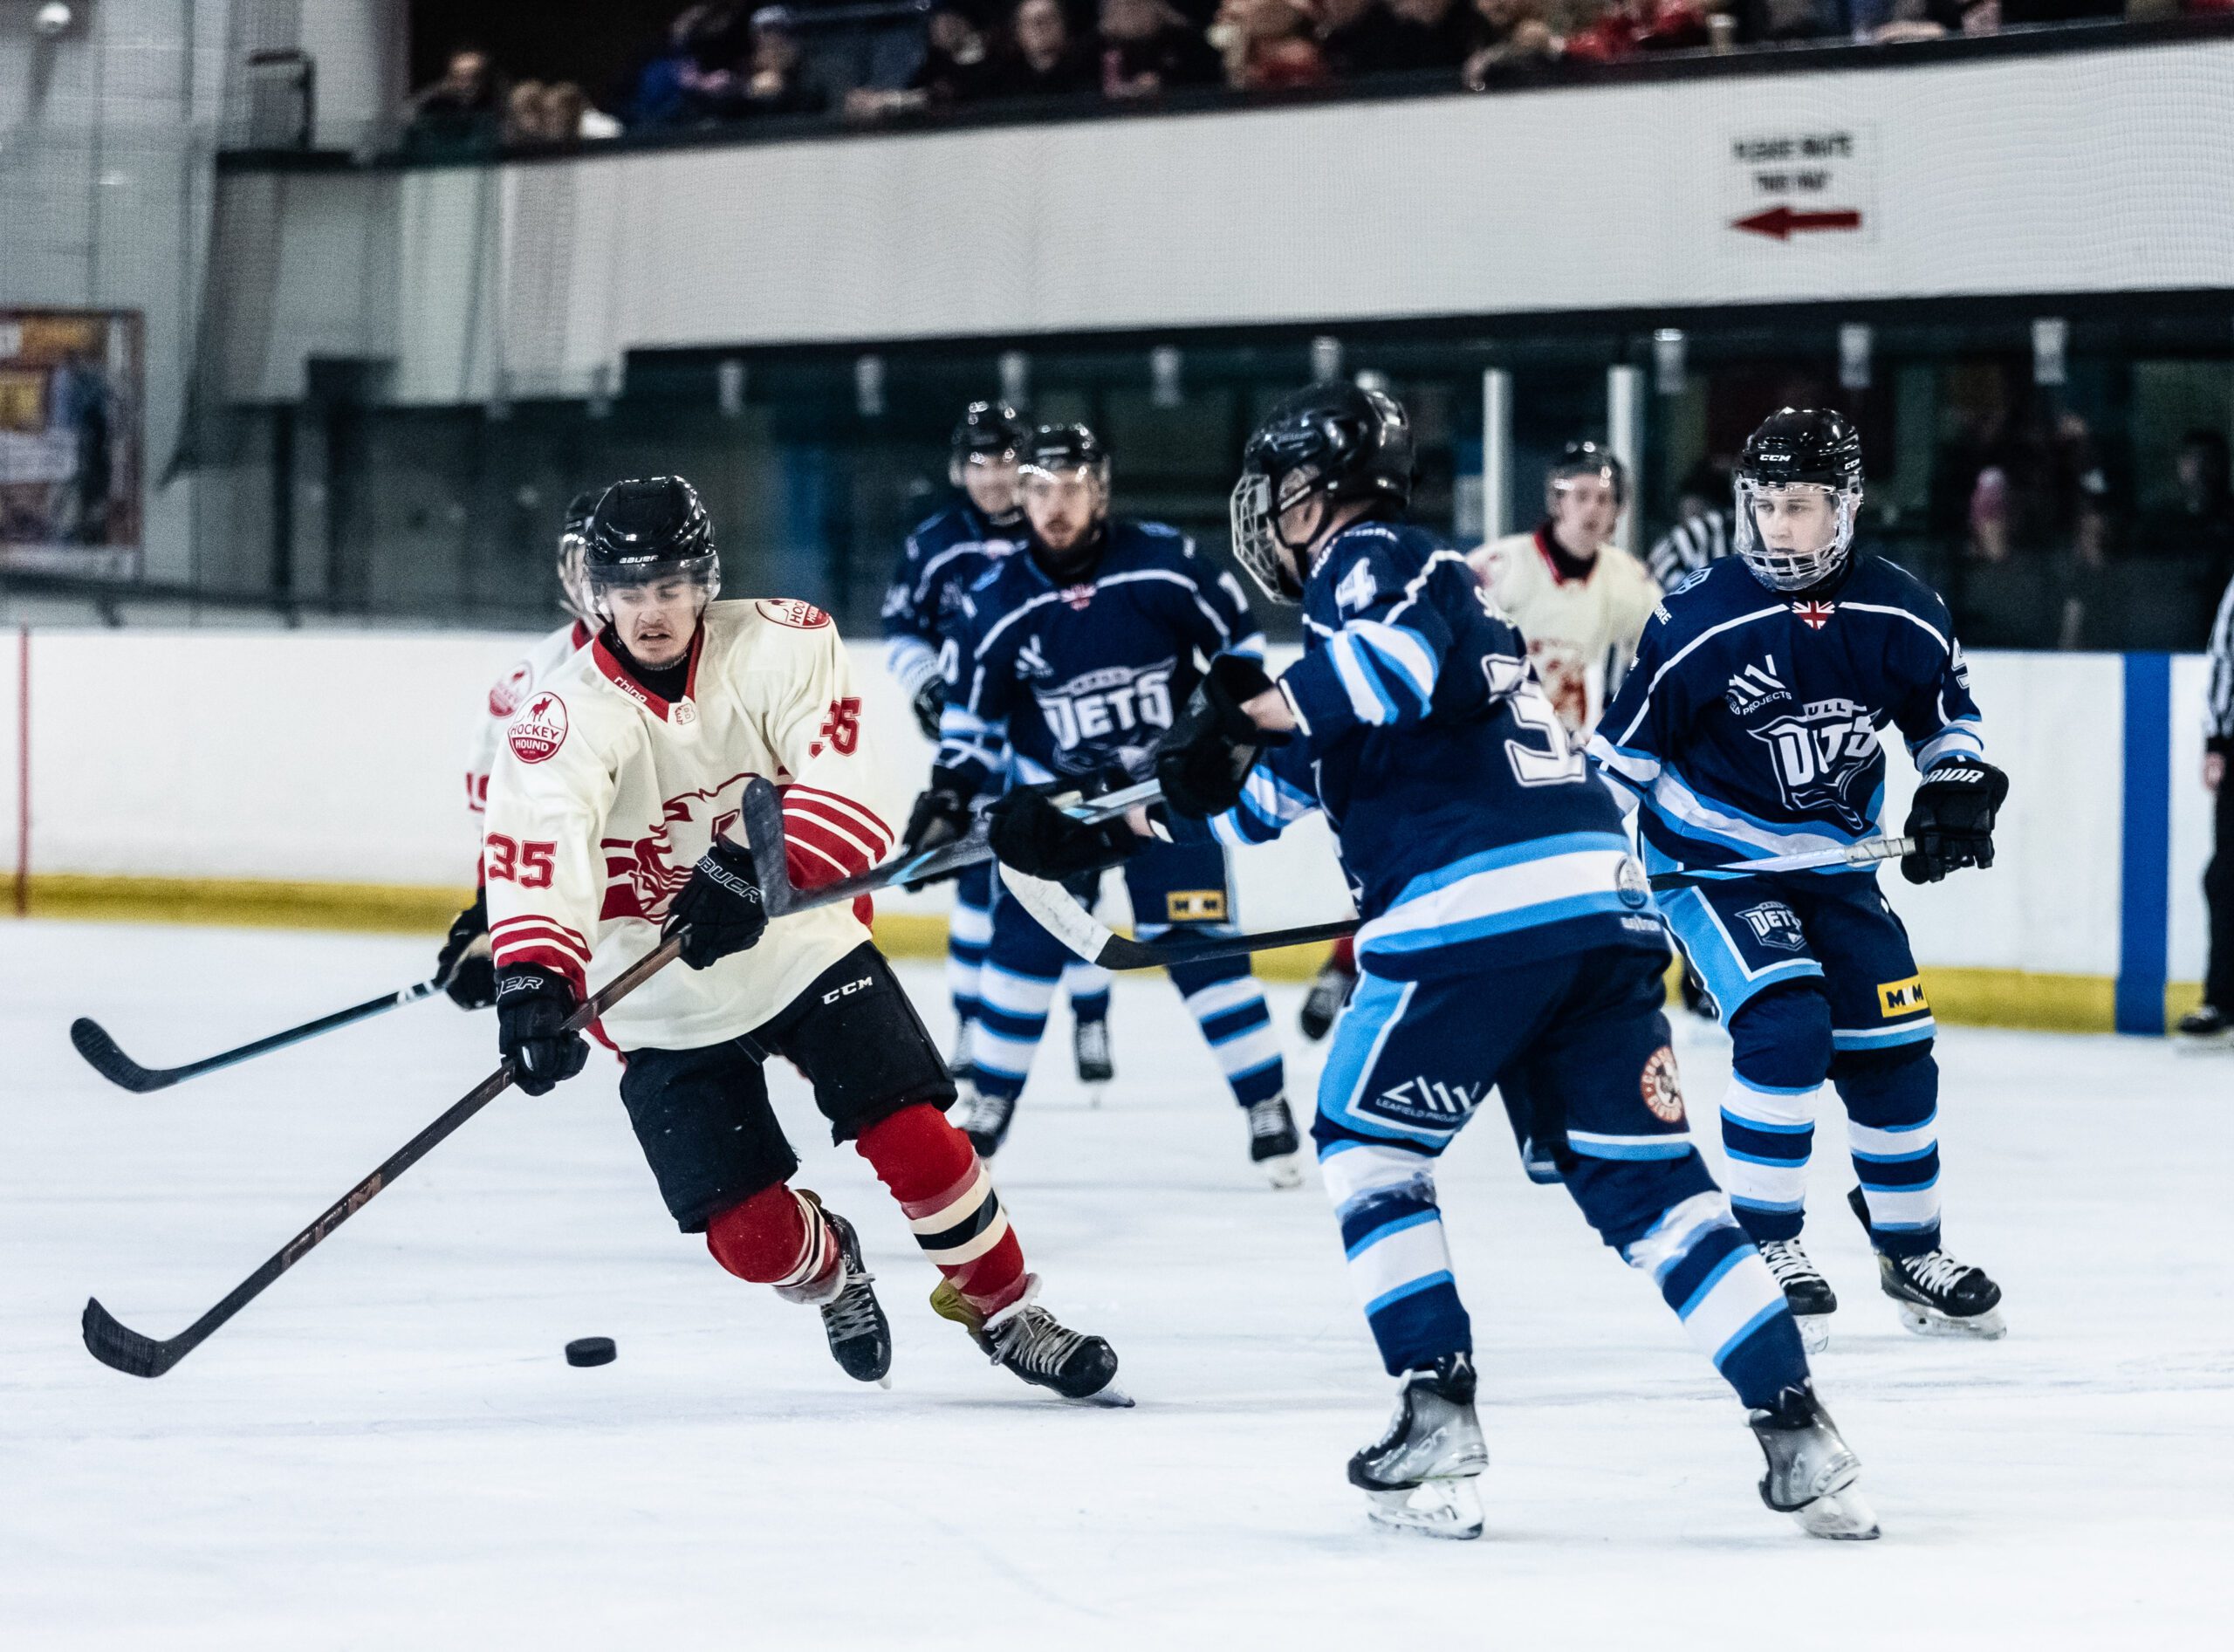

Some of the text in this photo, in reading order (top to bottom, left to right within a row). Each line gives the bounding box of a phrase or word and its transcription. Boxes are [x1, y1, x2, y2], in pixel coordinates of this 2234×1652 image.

[1742, 690, 1792, 716] PROJECTS
[510, 723, 560, 740] HOCKEY
[515, 738, 550, 752] HOUND
[484, 831, 558, 891] 35
[821, 976, 874, 1005] CCM
